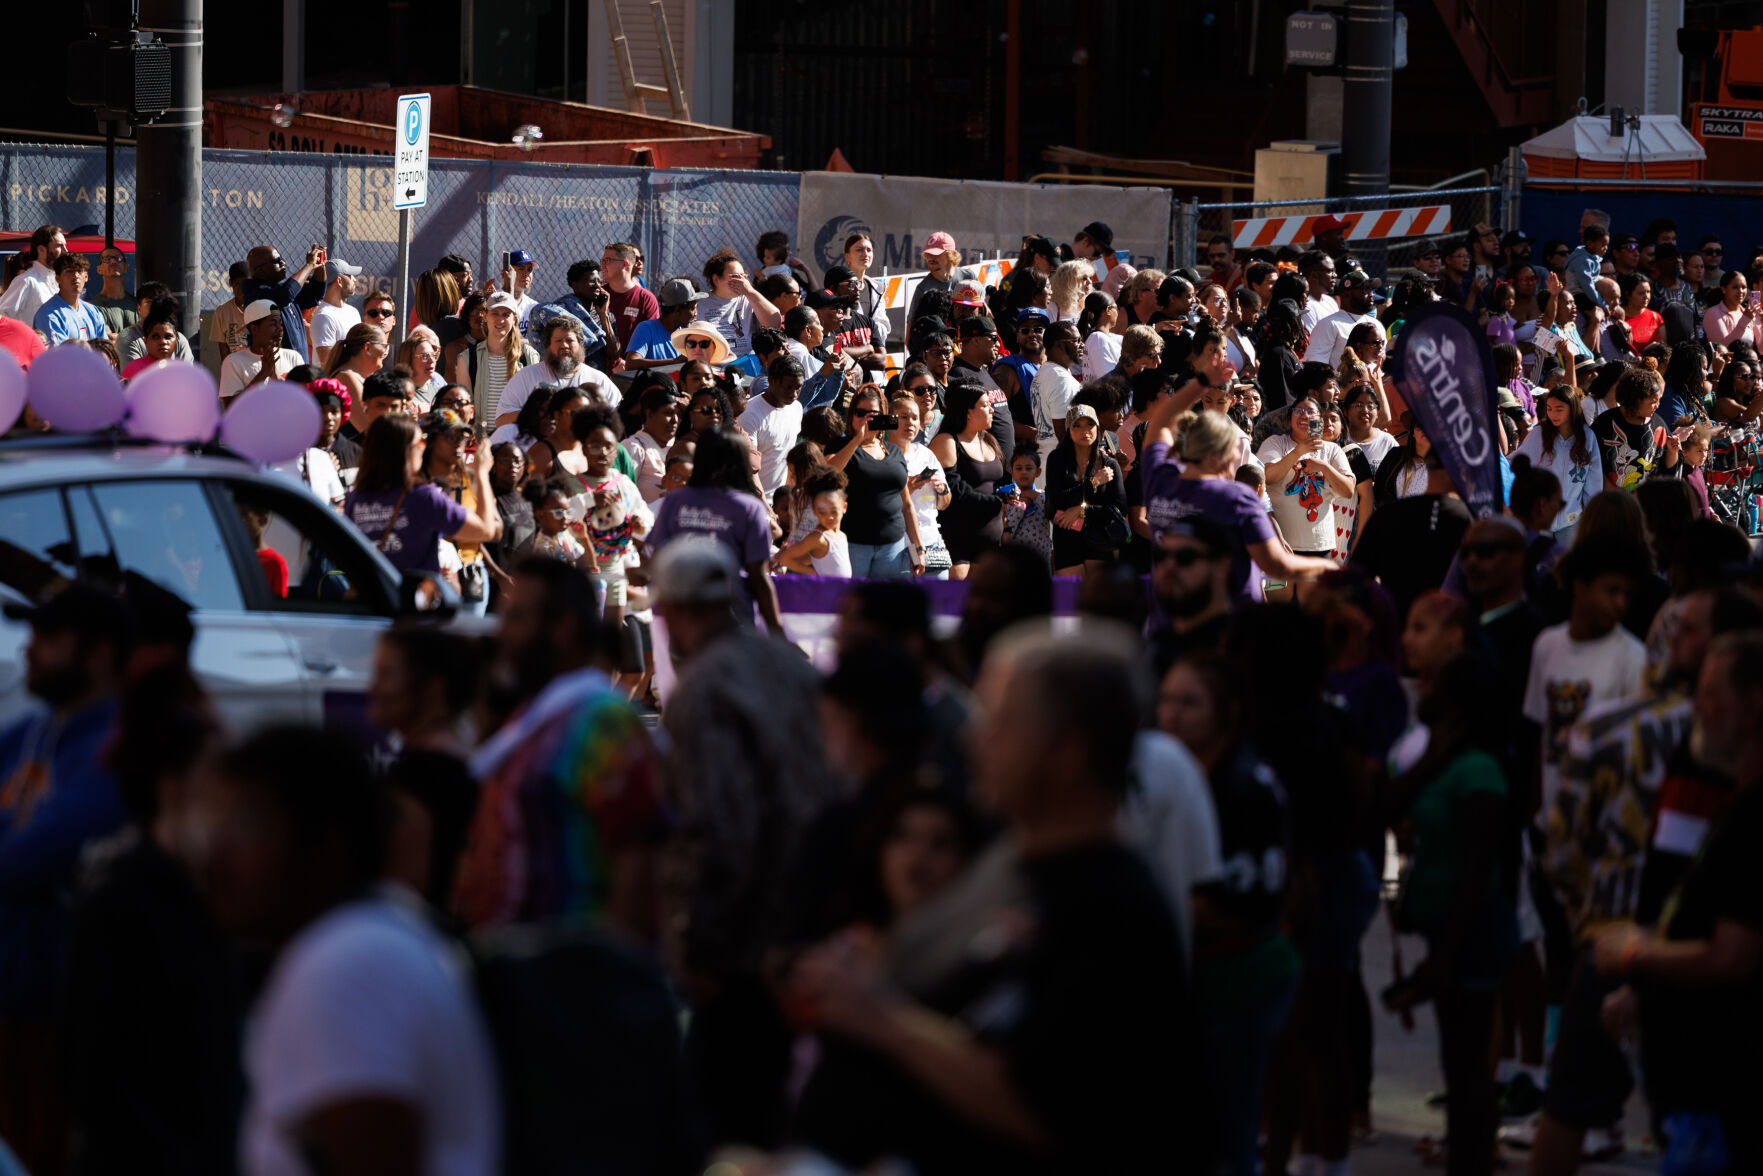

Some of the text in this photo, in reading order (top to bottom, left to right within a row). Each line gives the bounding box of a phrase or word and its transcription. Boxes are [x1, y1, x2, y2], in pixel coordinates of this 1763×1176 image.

[1291, 20, 1333, 31] NOT IN
[1289, 50, 1333, 60] SERVICE
[1705, 123, 1741, 135] RAKA
[401, 150, 423, 165] PAY AT
[398, 170, 424, 185] STATION
[10, 184, 130, 205] PICKARD
[624, 199, 720, 214] ASSOCIATES
